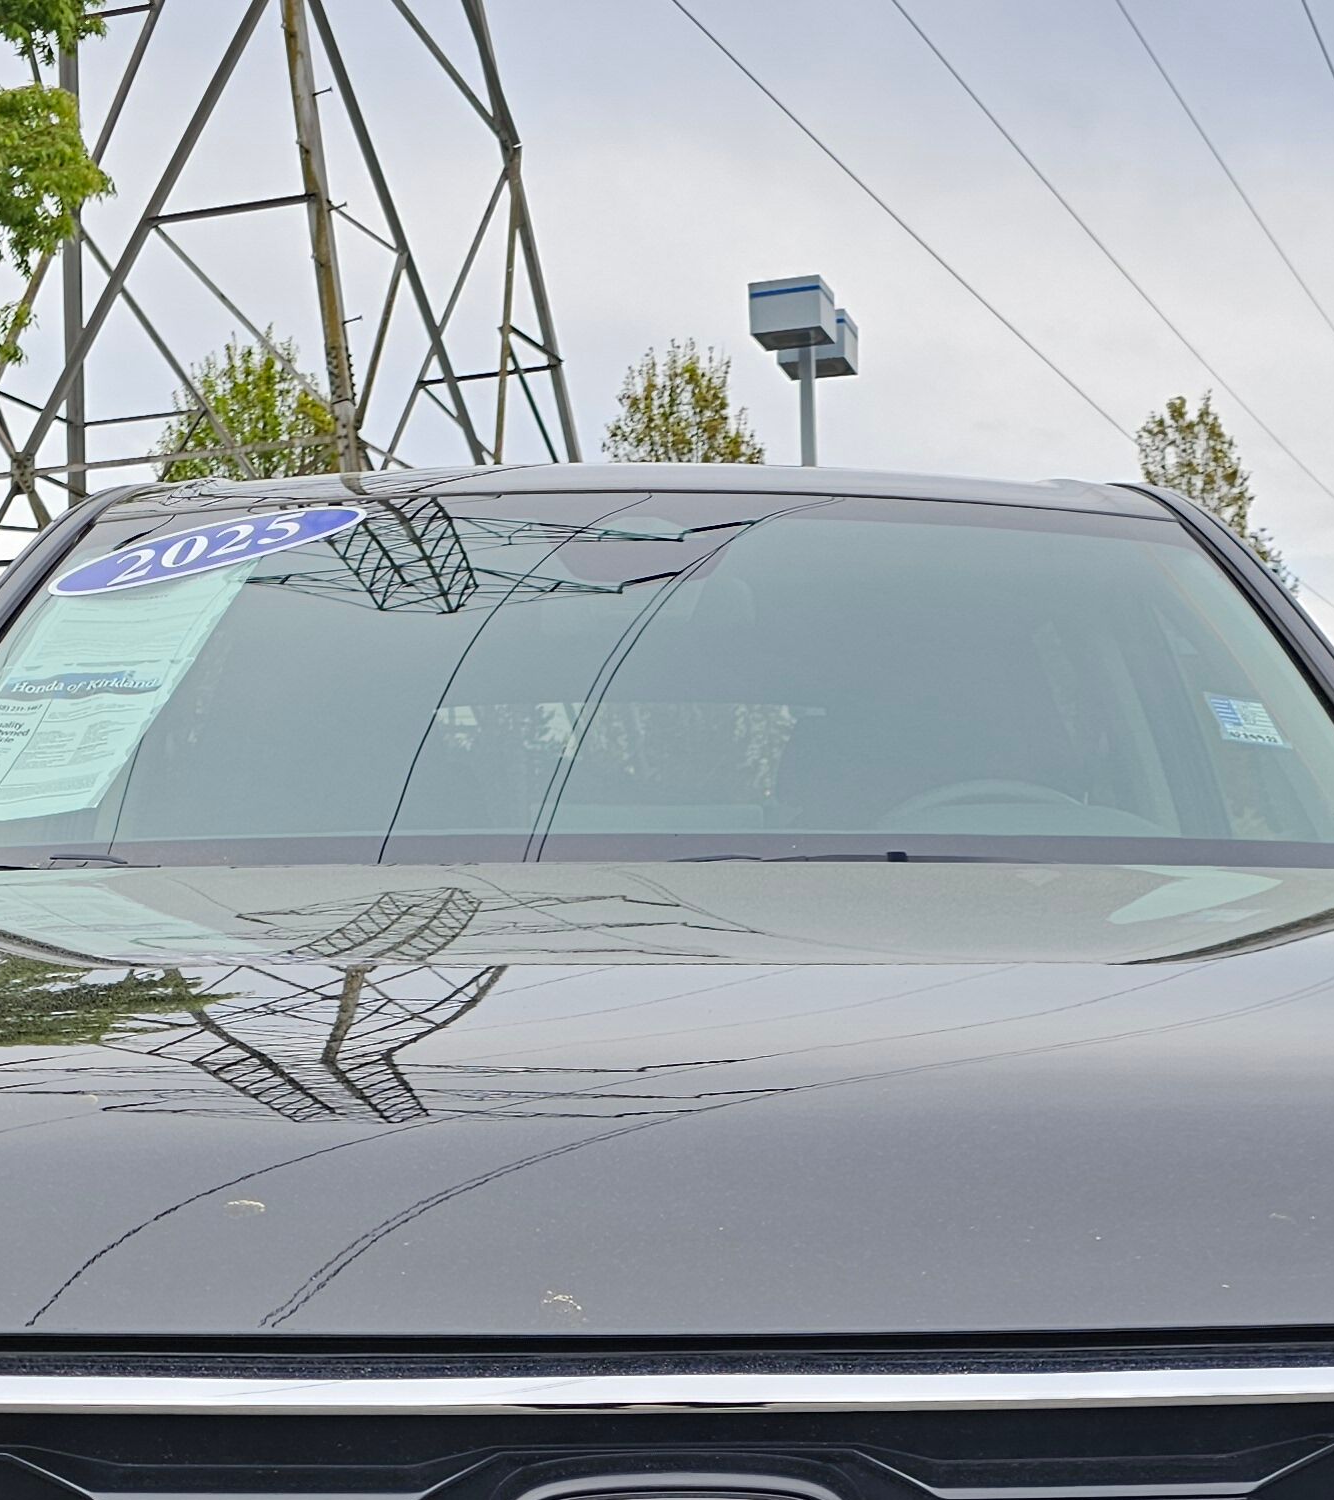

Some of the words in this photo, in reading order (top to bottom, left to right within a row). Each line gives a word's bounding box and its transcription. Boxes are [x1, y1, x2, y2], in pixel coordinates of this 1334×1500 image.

[106, 512, 307, 585] 2025
[10, 680, 63, 694] Honda
[66, 681, 84, 693] of
[85, 677, 158, 691] Kirkland
